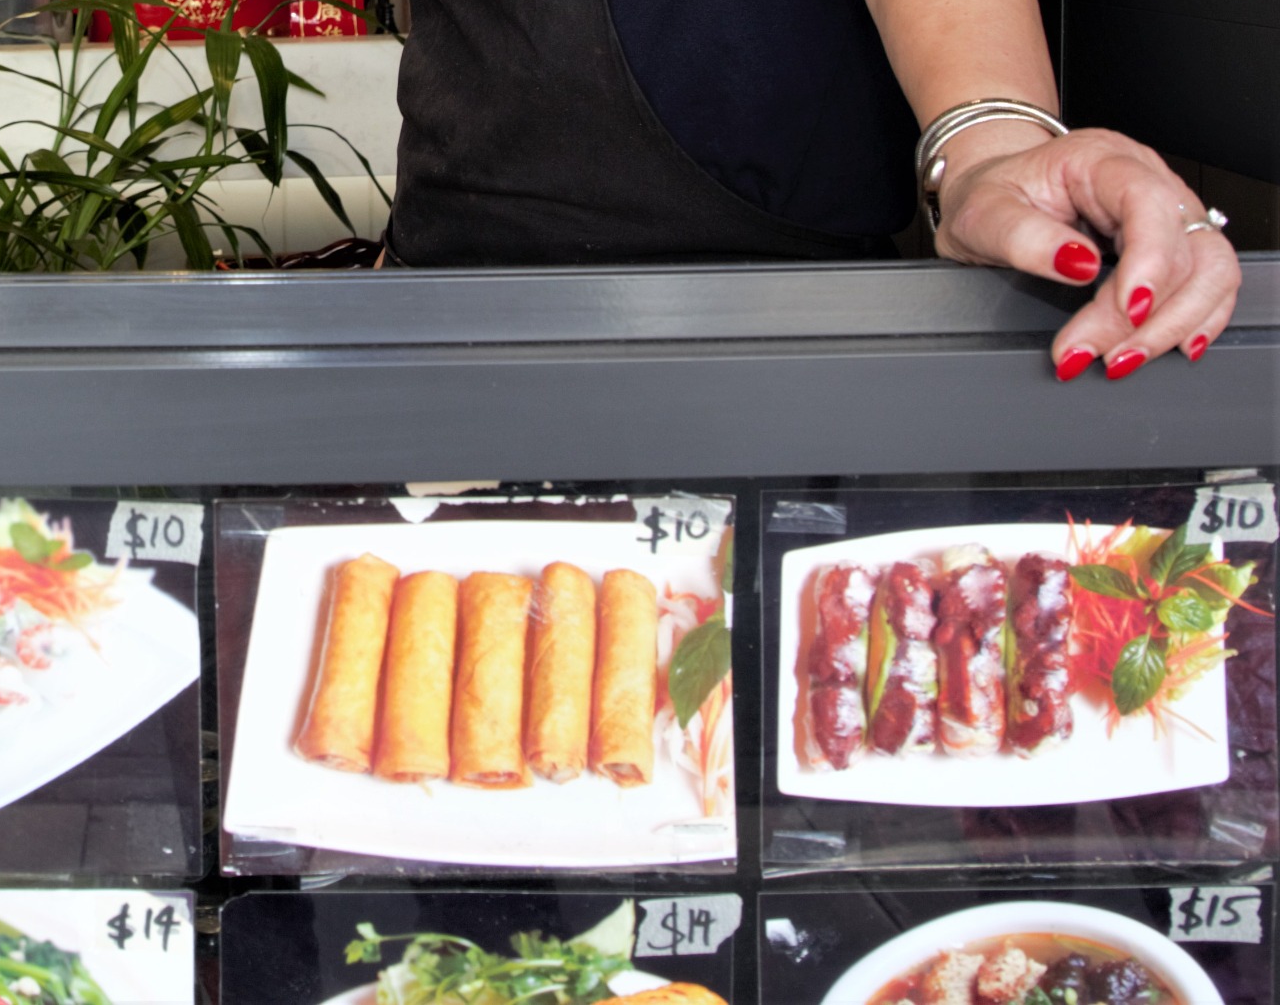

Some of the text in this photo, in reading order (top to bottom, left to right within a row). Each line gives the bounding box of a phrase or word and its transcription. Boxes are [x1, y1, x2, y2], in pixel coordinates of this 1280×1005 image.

[124, 508, 184, 559] $10
[636, 506, 710, 553] $10
[1200, 497, 1264, 533] $10
[108, 902, 182, 952] $14
[647, 902, 716, 956] $14
[1178, 887, 1263, 934] $15
